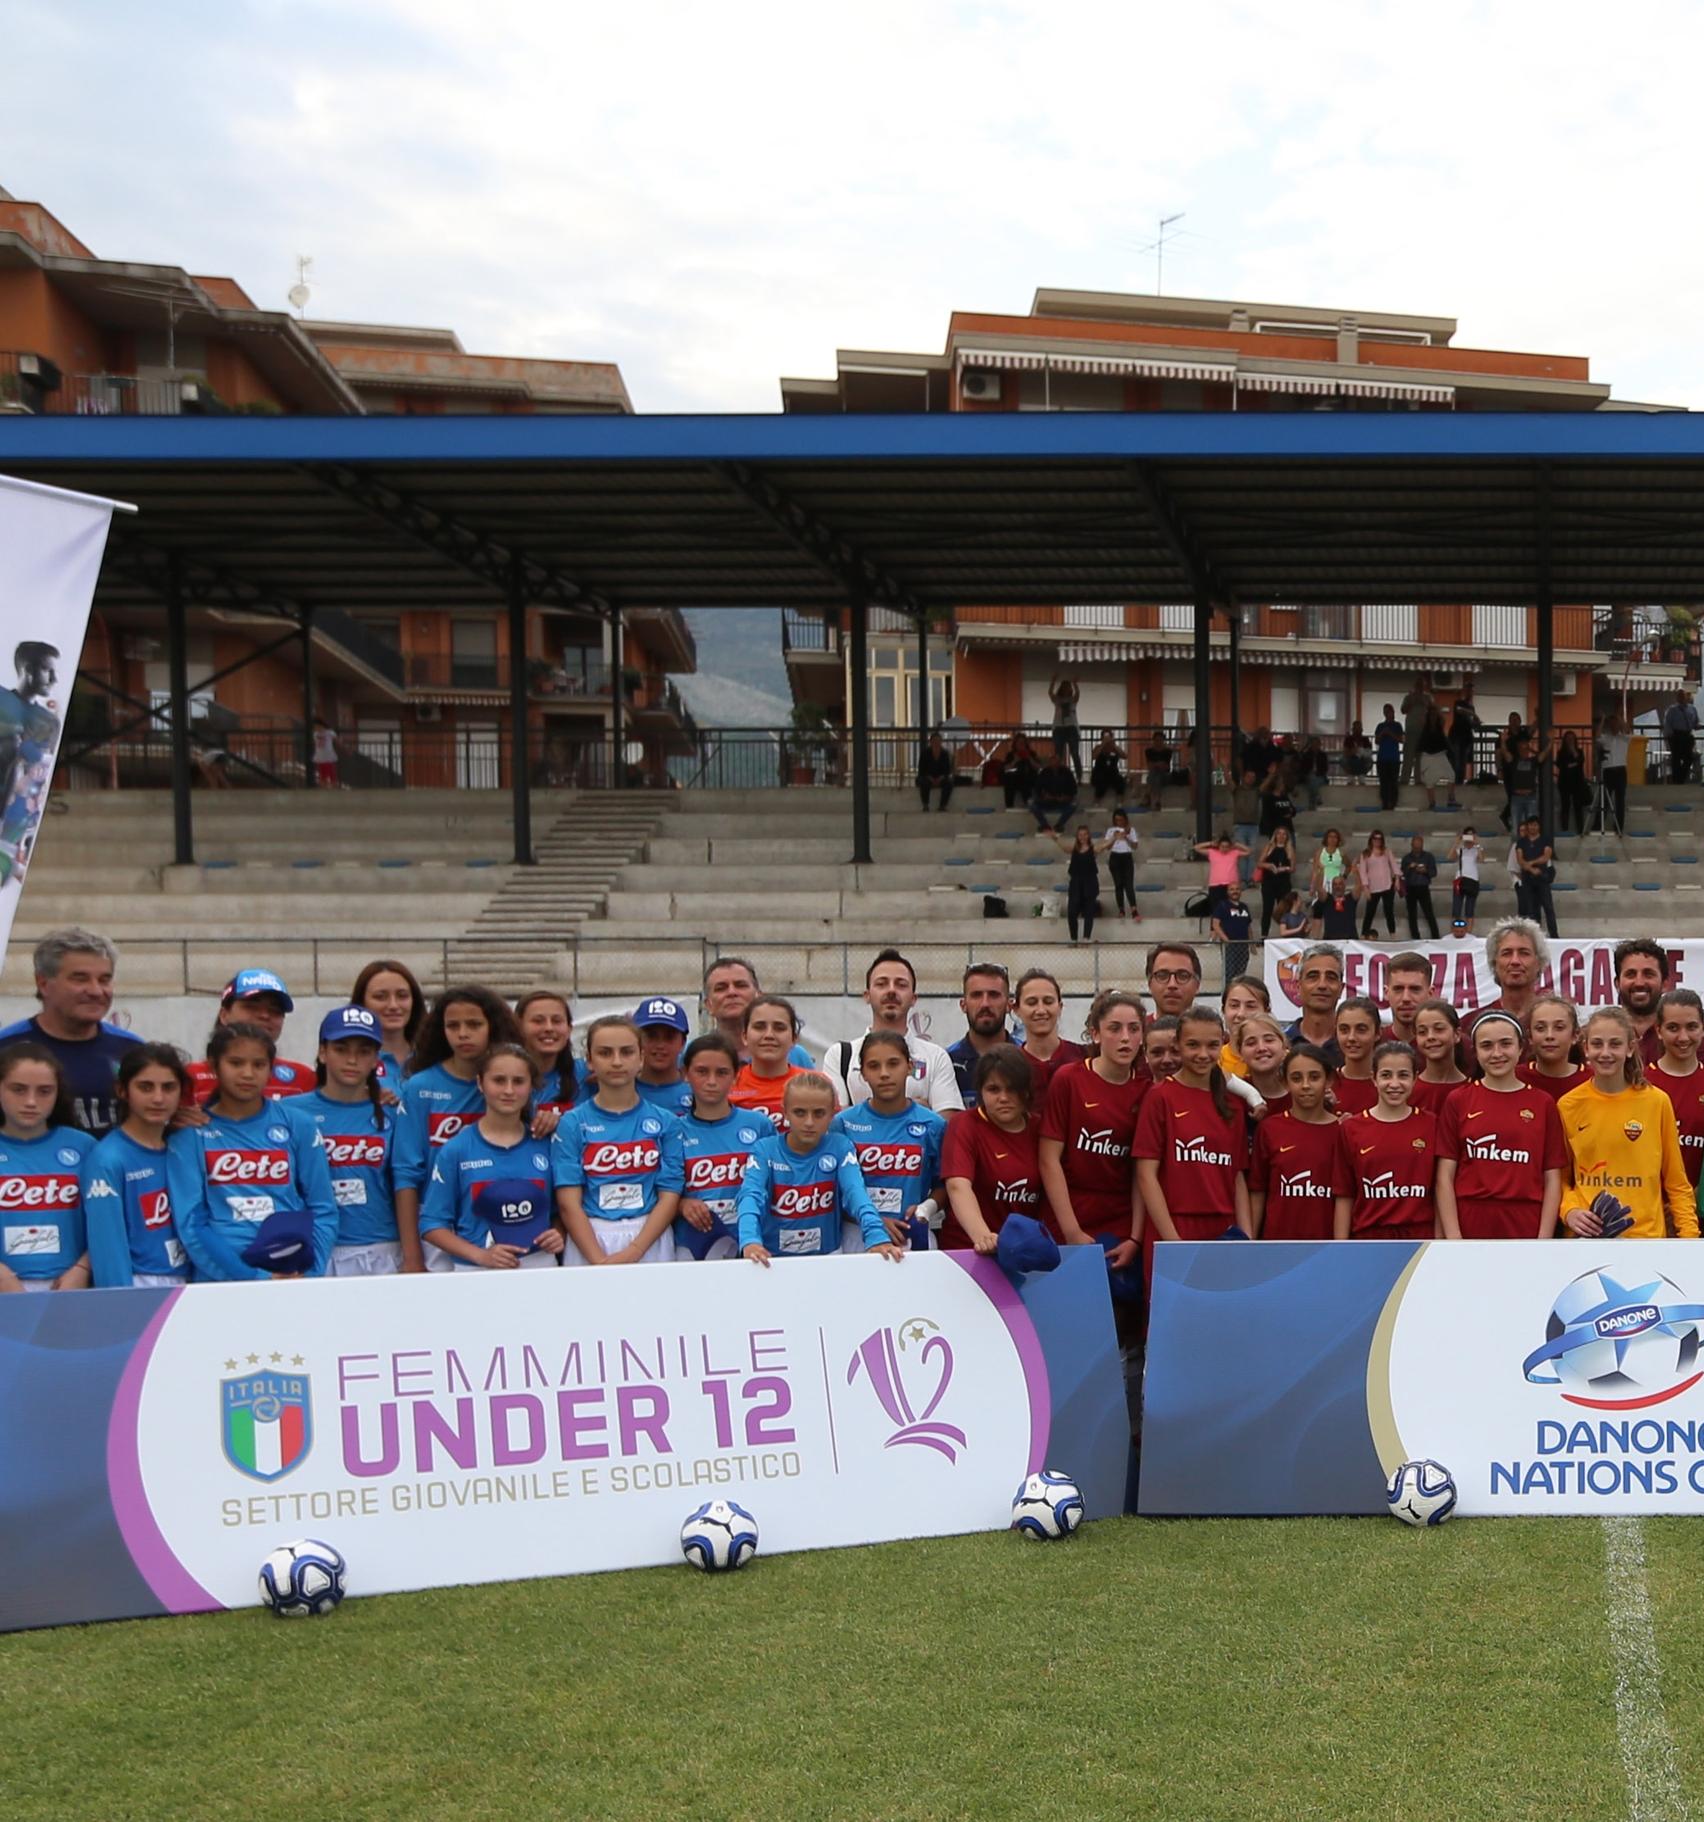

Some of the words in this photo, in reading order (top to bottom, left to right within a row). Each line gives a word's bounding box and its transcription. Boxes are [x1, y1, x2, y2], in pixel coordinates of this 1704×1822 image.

[1345, 952, 1480, 1009] FOZA
[208, 1152, 289, 1182] Lete
[584, 1145, 659, 1173] Lete
[860, 1146, 921, 1171] Lete
[0, 1178, 79, 1208] Lete
[771, 1187, 834, 1215] Lete
[1364, 1181, 1426, 1199] linkem
[338, 1328, 789, 1401] FEMMINILE
[228, 1380, 304, 1401] ITALIA
[339, 1383, 674, 1478] UNDER
[701, 1376, 797, 1449] 12
[221, 1487, 380, 1528] SETTORE
[391, 1470, 570, 1512] GIOVANILE
[581, 1468, 600, 1496] E
[610, 1451, 801, 1492] SCOLASTICO
[1490, 1459, 1679, 1495] NATIONS
